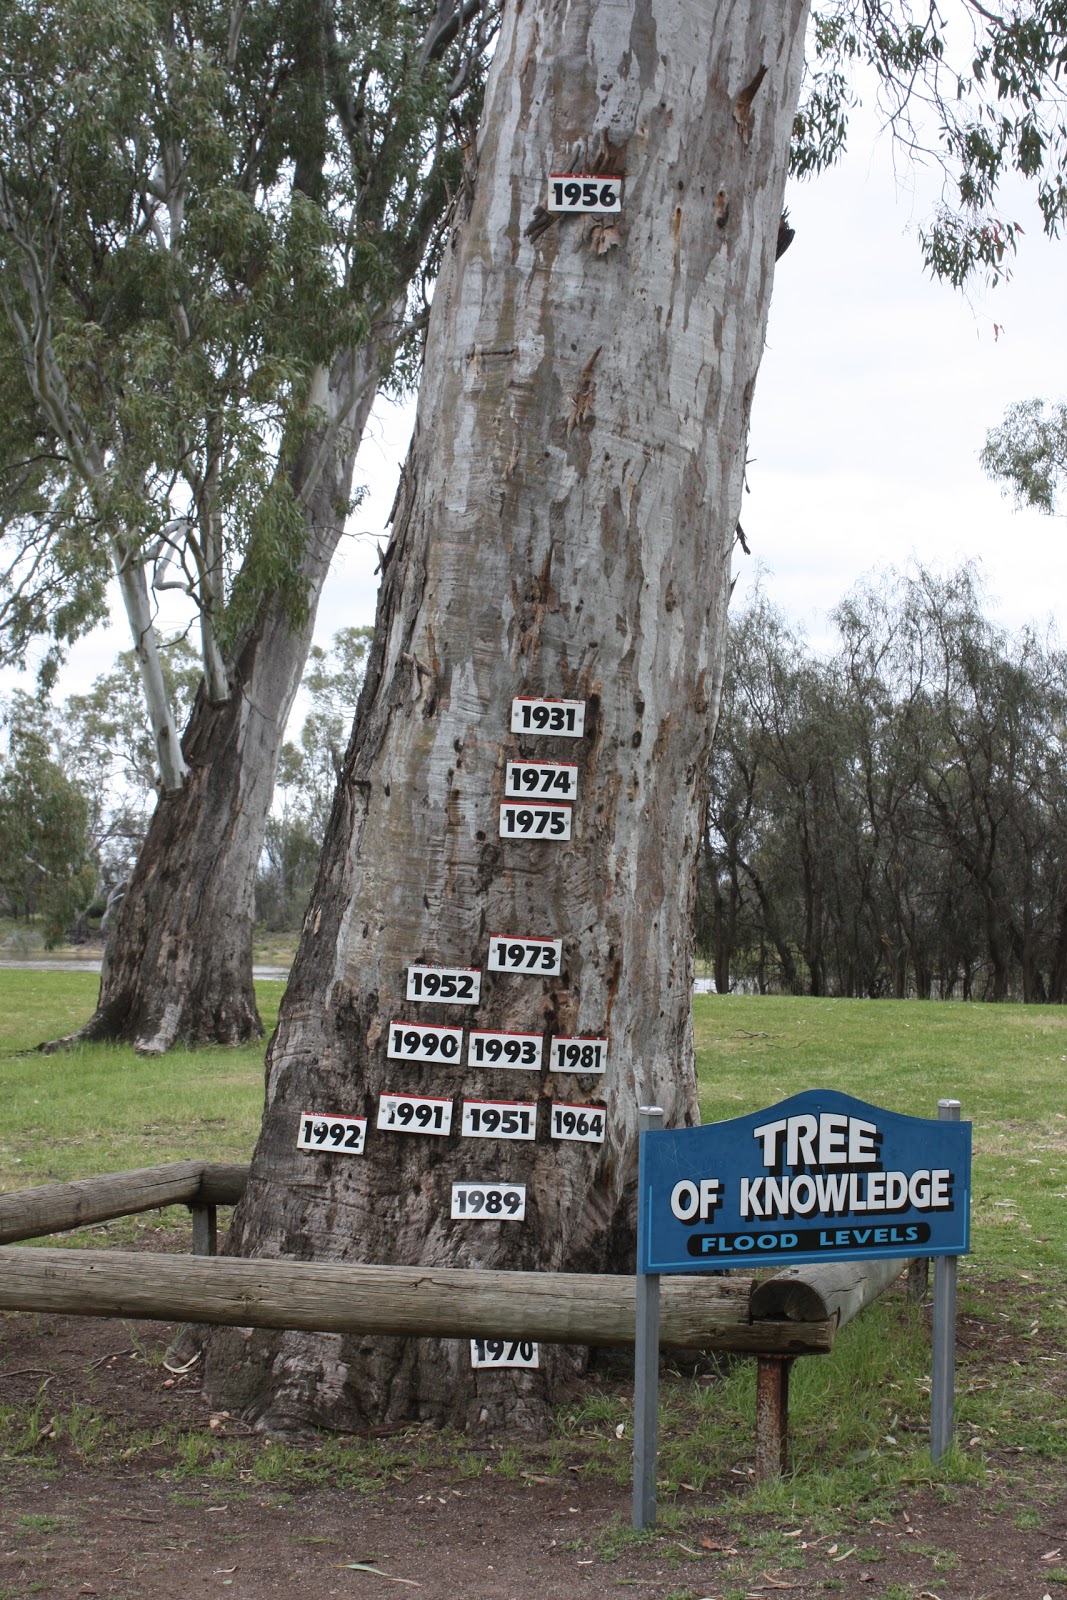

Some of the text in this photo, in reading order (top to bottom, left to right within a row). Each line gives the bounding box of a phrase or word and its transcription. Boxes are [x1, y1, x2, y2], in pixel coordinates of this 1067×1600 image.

[554, 183, 616, 206] 1956
[522, 706, 575, 731] 1931
[511, 768, 571, 793] 1974
[506, 810, 565, 834] 1975
[497, 944, 557, 969] 1973
[413, 973, 474, 998] 1952
[393, 1030, 457, 1058] 1990
[474, 1038, 536, 1064] 1993
[557, 1044, 601, 1068] 1981
[387, 1101, 442, 1129] 1991
[470, 1109, 530, 1134] 1951
[555, 1112, 602, 1137] 1964
[304, 1121, 360, 1148] 1992
[753, 1113, 877, 1167] TREE
[457, 1190, 520, 1214] 1989
[671, 1169, 950, 1221] OF KNOWLEDGE
[702, 1227, 918, 1252] FLOOD LEVELS
[476, 1339, 533, 1362] 1970
